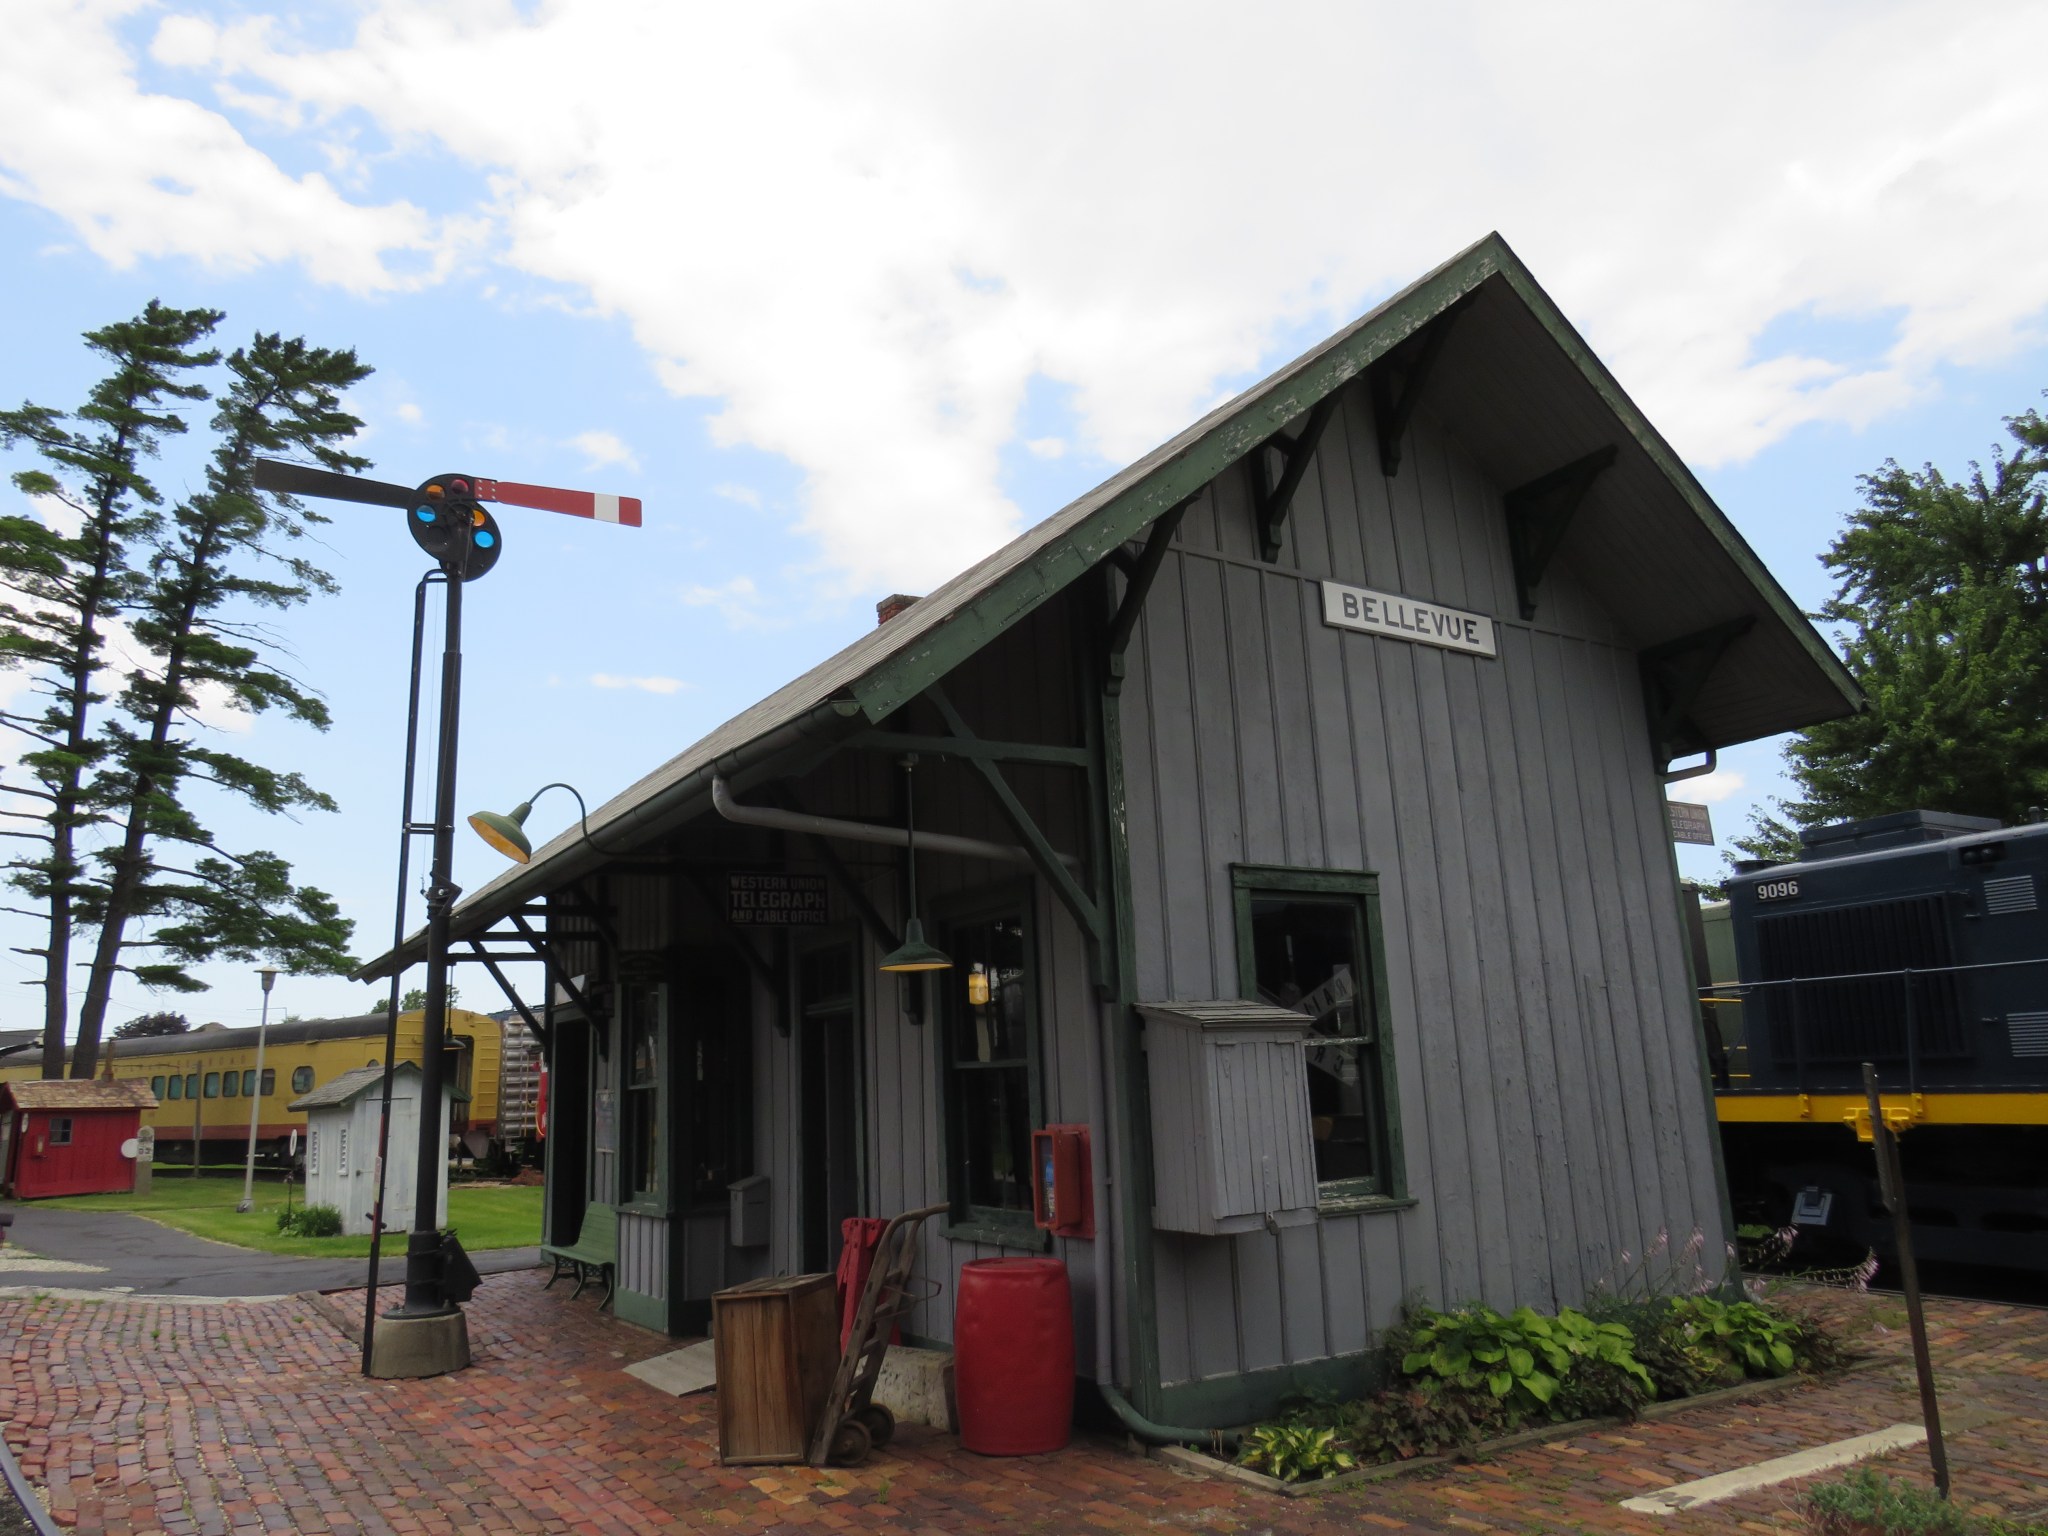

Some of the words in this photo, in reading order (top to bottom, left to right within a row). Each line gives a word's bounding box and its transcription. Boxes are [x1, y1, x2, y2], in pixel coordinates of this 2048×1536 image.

[1342, 592, 1480, 645] BELLEVUE
[1671, 819, 1705, 831] ELEGRAPH
[730, 876, 788, 889] WESTERN
[790, 878, 826, 890] UNION
[1757, 881, 1798, 899] 9096
[730, 891, 826, 908] TELEGRAPH
[732, 909, 753, 920] AND
[755, 910, 788, 923] CABLE
[790, 910, 826, 923] OFFICE
